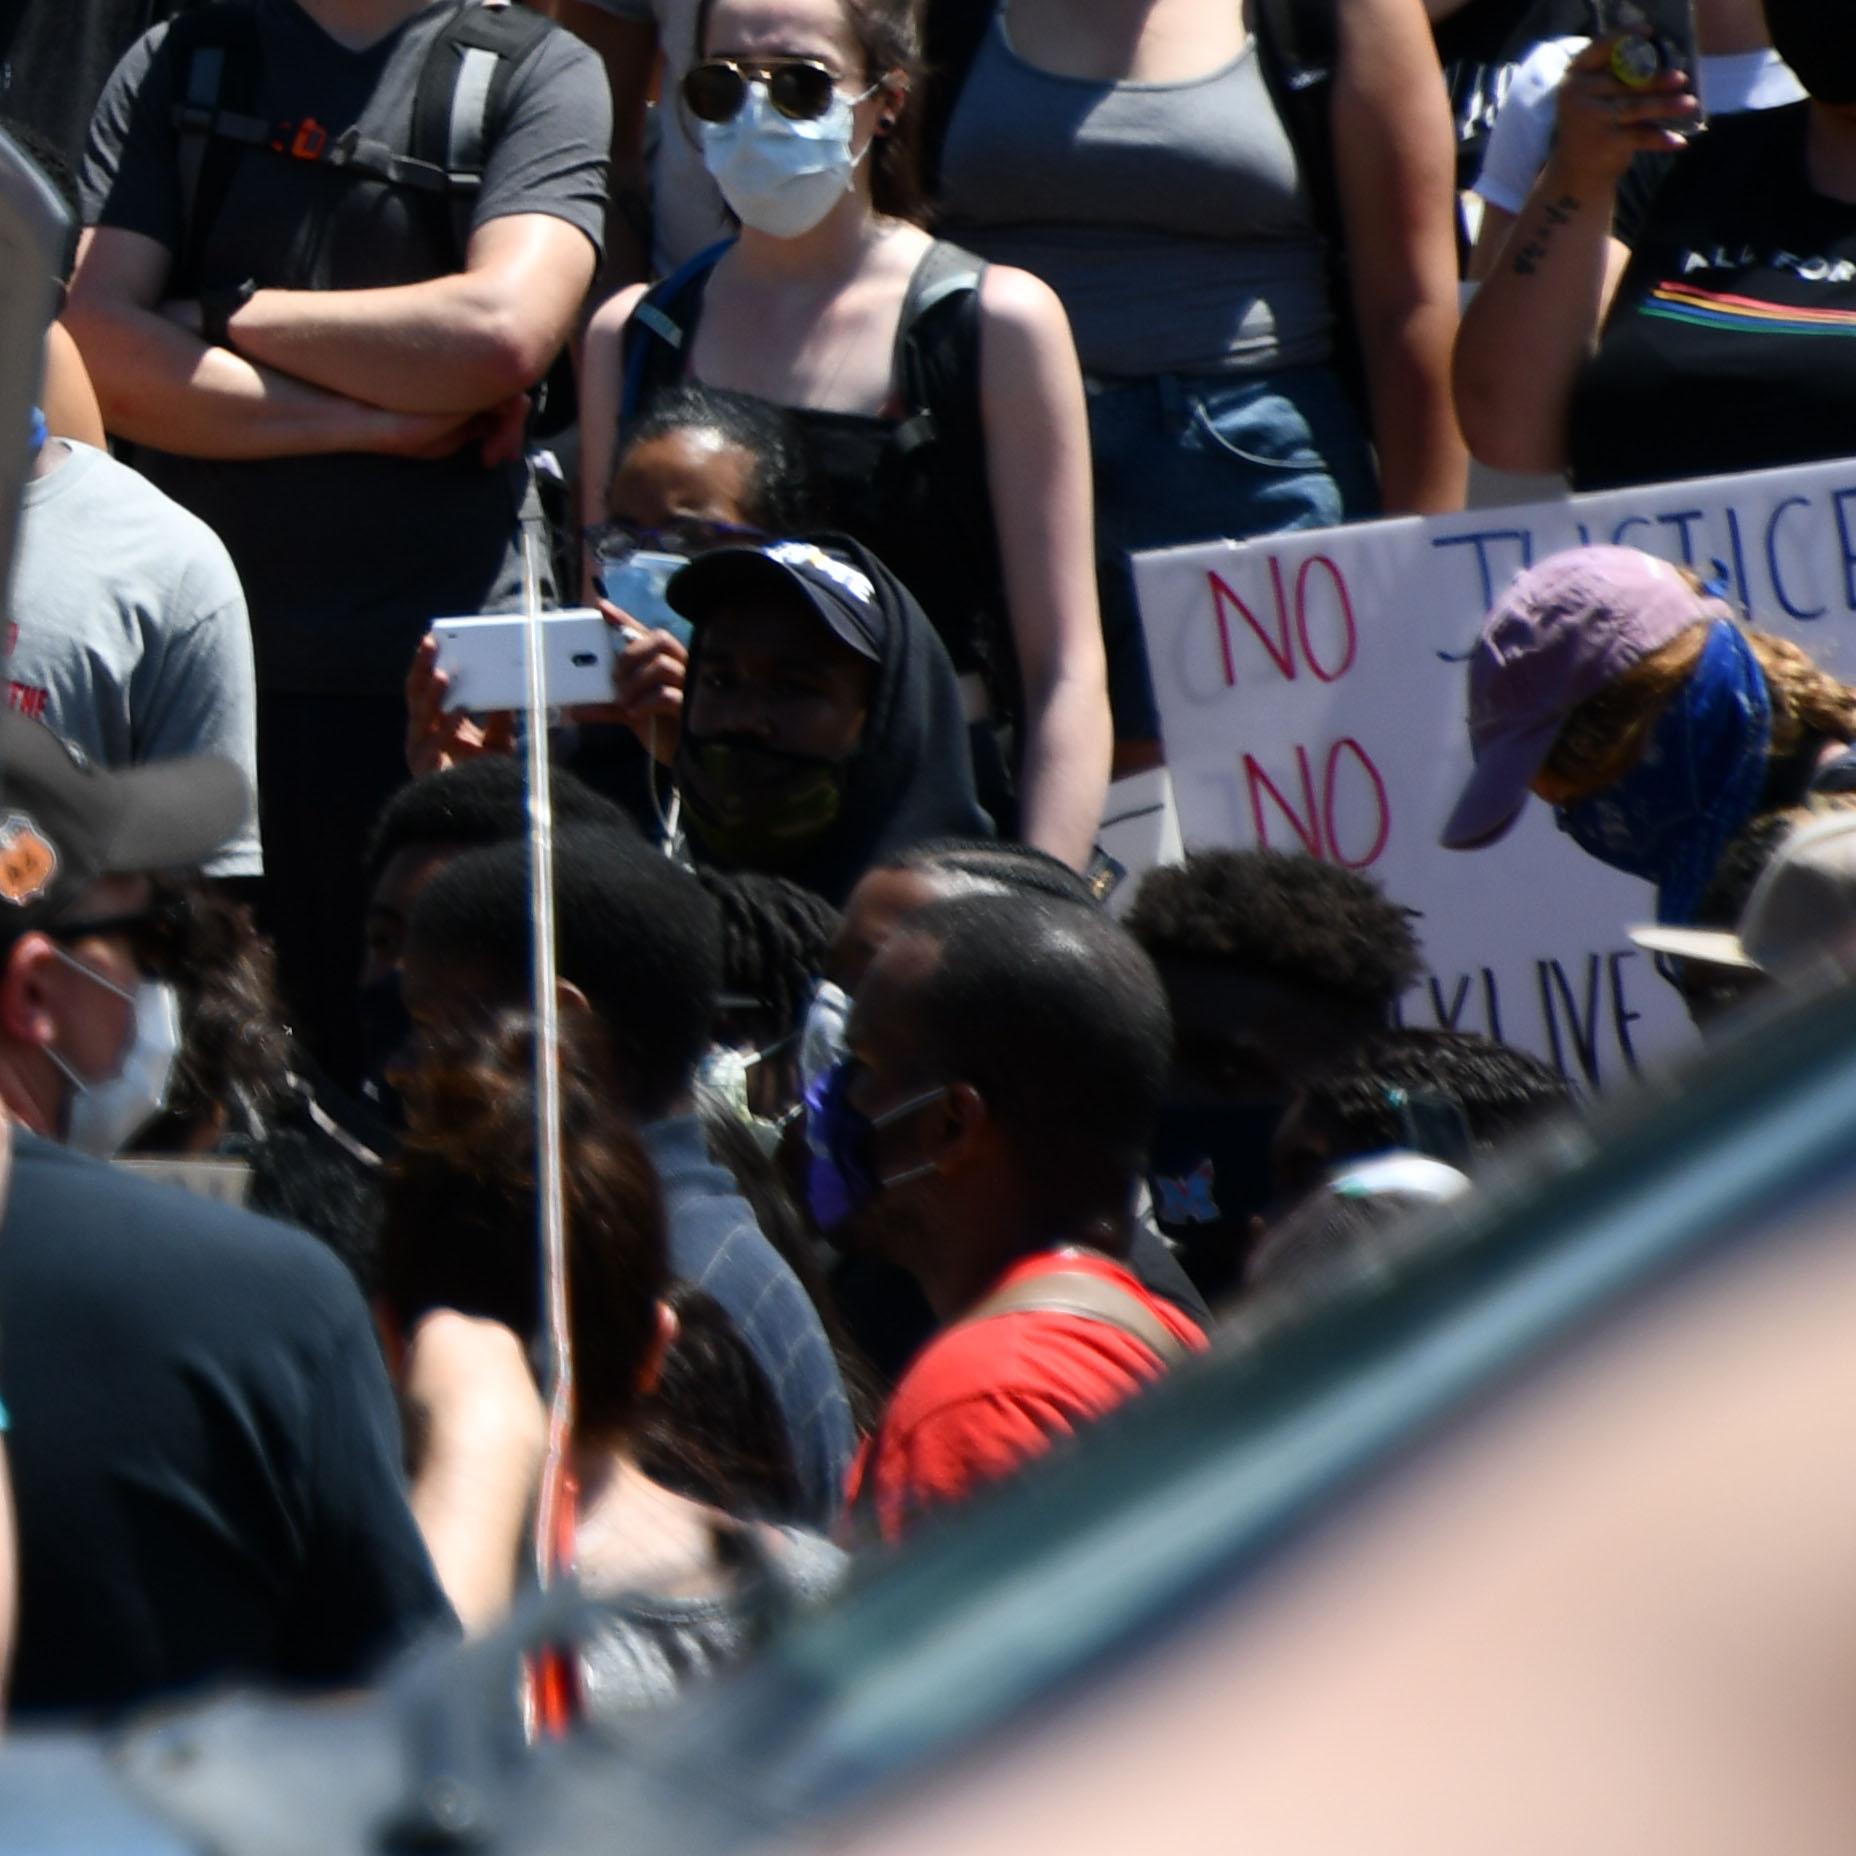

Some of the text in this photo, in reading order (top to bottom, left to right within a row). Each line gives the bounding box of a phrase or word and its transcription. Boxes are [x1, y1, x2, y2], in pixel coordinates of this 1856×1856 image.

[1207, 486, 1856, 687] NO JTICE
[1243, 737, 1392, 871] NO
